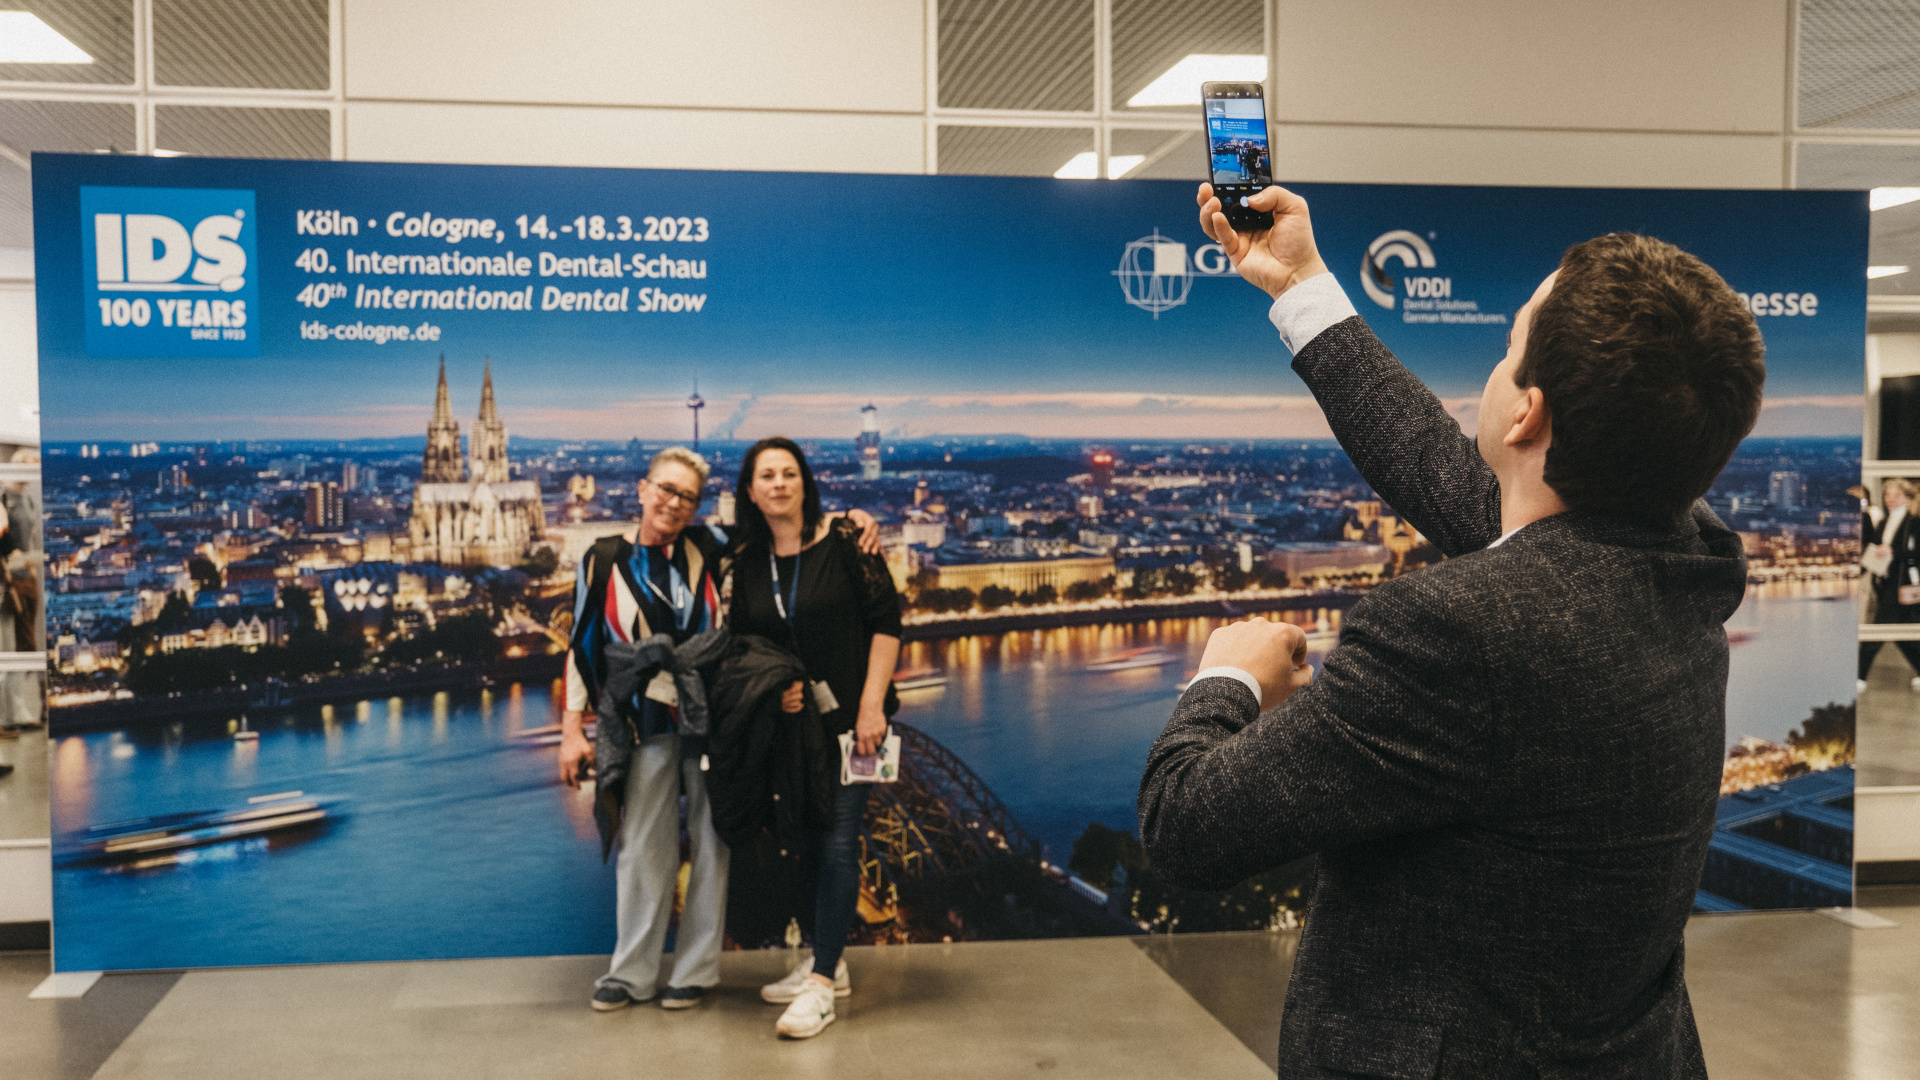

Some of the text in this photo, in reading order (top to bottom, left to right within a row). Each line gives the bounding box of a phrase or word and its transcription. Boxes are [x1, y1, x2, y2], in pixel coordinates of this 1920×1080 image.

[297, 209, 710, 244] Köln Cologne, 14.-18.3.2023
[295, 247, 707, 280] 40. Internationale Dental-Schau
[355, 283, 534, 311] International
[541, 285, 630, 312] Dental
[637, 287, 708, 313] Show
[1404, 276, 1451, 299] VDDI
[98, 298, 247, 329] 100 YEARS
[1403, 298, 1434, 310] Dental
[1403, 311, 1440, 323] German
[191, 328, 220, 341] SINCE
[300, 321, 441, 345] ids-cologne.de
